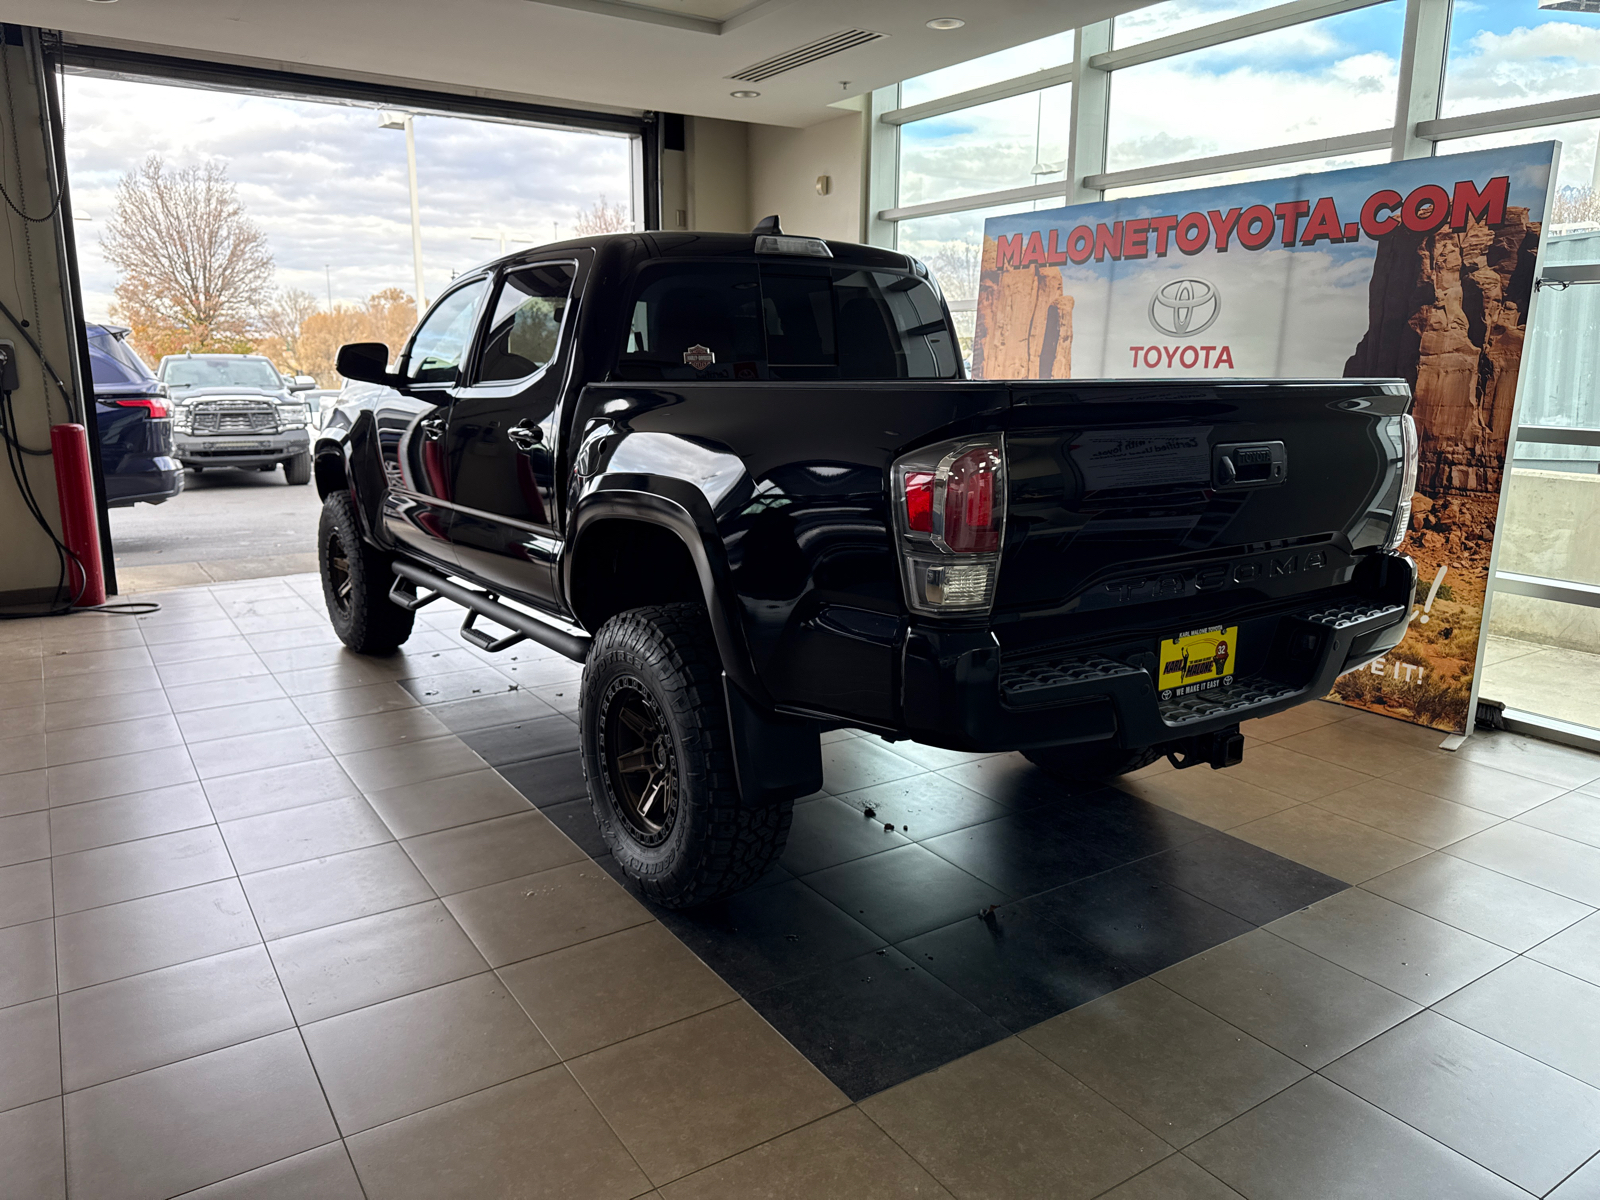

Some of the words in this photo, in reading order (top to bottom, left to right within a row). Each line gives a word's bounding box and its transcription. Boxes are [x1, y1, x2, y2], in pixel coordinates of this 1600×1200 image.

[996, 175, 1510, 270] MALONETOYOTA.COM
[1129, 345, 1234, 369] TOYOTA
[1239, 450, 1271, 463] TOYOTA
[1105, 549, 1328, 603] TACOMA
[1191, 627, 1208, 636] MALONE
[1217, 645, 1226, 655] 32
[1163, 659, 1184, 676] KARL
[1185, 660, 1214, 678] MALONE
[1394, 661, 1424, 685] IT!
[1176, 687, 1184, 697] WE
[1185, 684, 1200, 694] MAKE
[1200, 682, 1206, 691] IT
[1207, 680, 1220, 689] EASY
